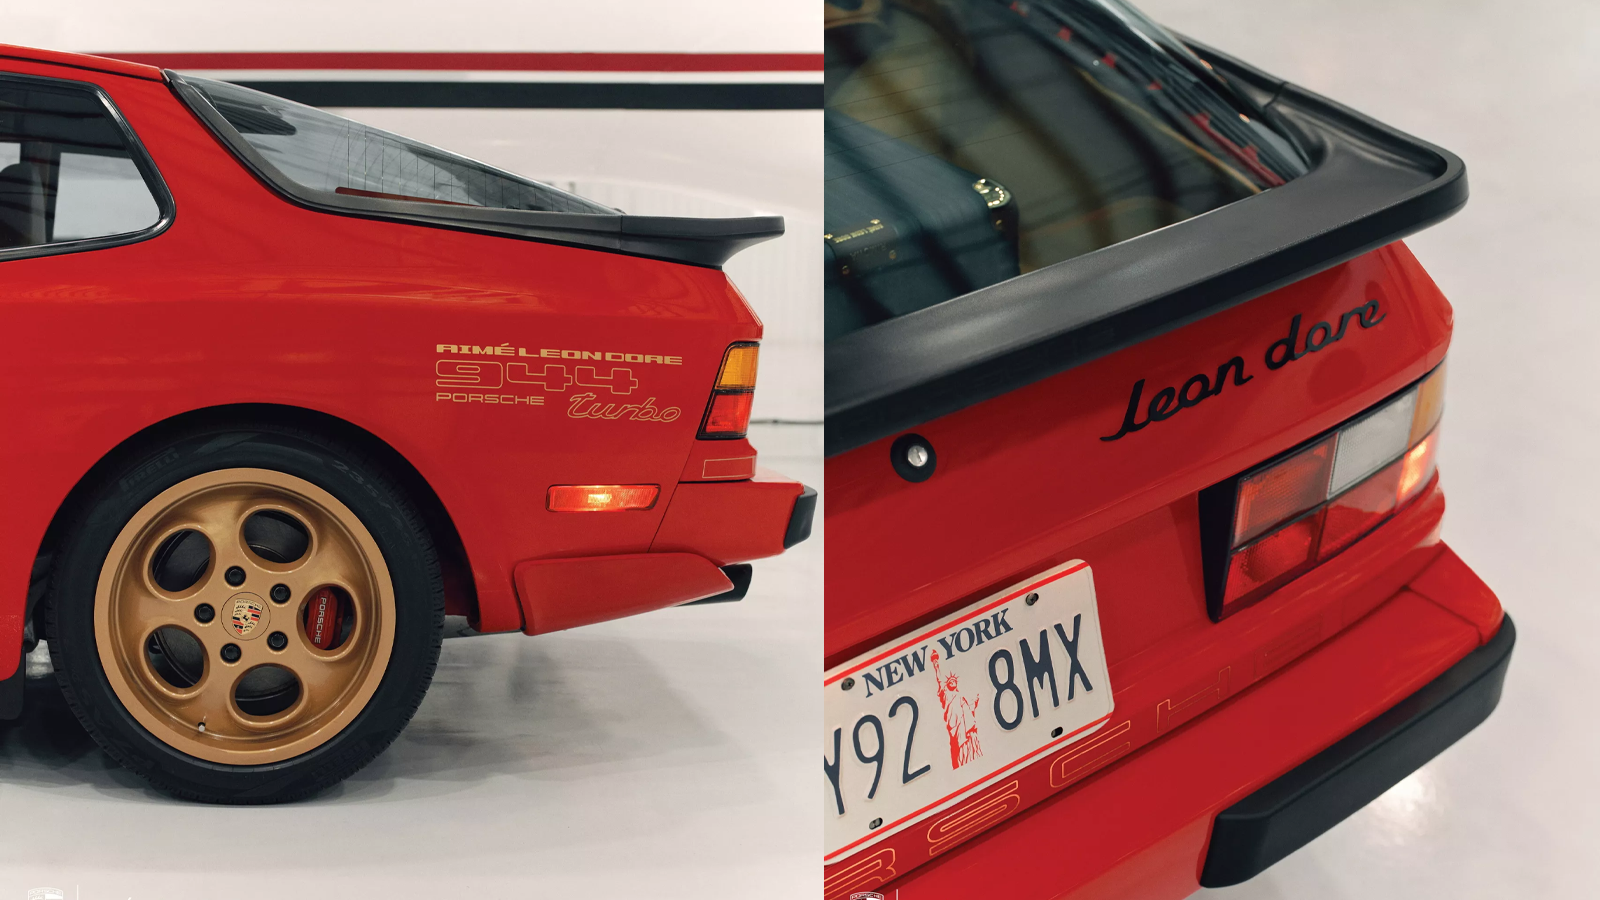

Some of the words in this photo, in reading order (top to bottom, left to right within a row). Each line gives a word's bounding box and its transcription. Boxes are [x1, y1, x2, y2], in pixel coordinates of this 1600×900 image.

[436, 343, 515, 356] AIMÉ
[519, 348, 602, 361] LEON
[605, 352, 683, 365] DORE
[1100, 354, 1253, 442] leon
[1264, 299, 1387, 371] dore
[436, 360, 638, 395] 944
[436, 392, 545, 406] PORSCHE
[567, 392, 682, 423] turbo
[314, 597, 327, 644] PORSCHE
[861, 645, 928, 698] NEW
[937, 608, 1013, 660] YORK
[988, 613, 1093, 731] 8MX
